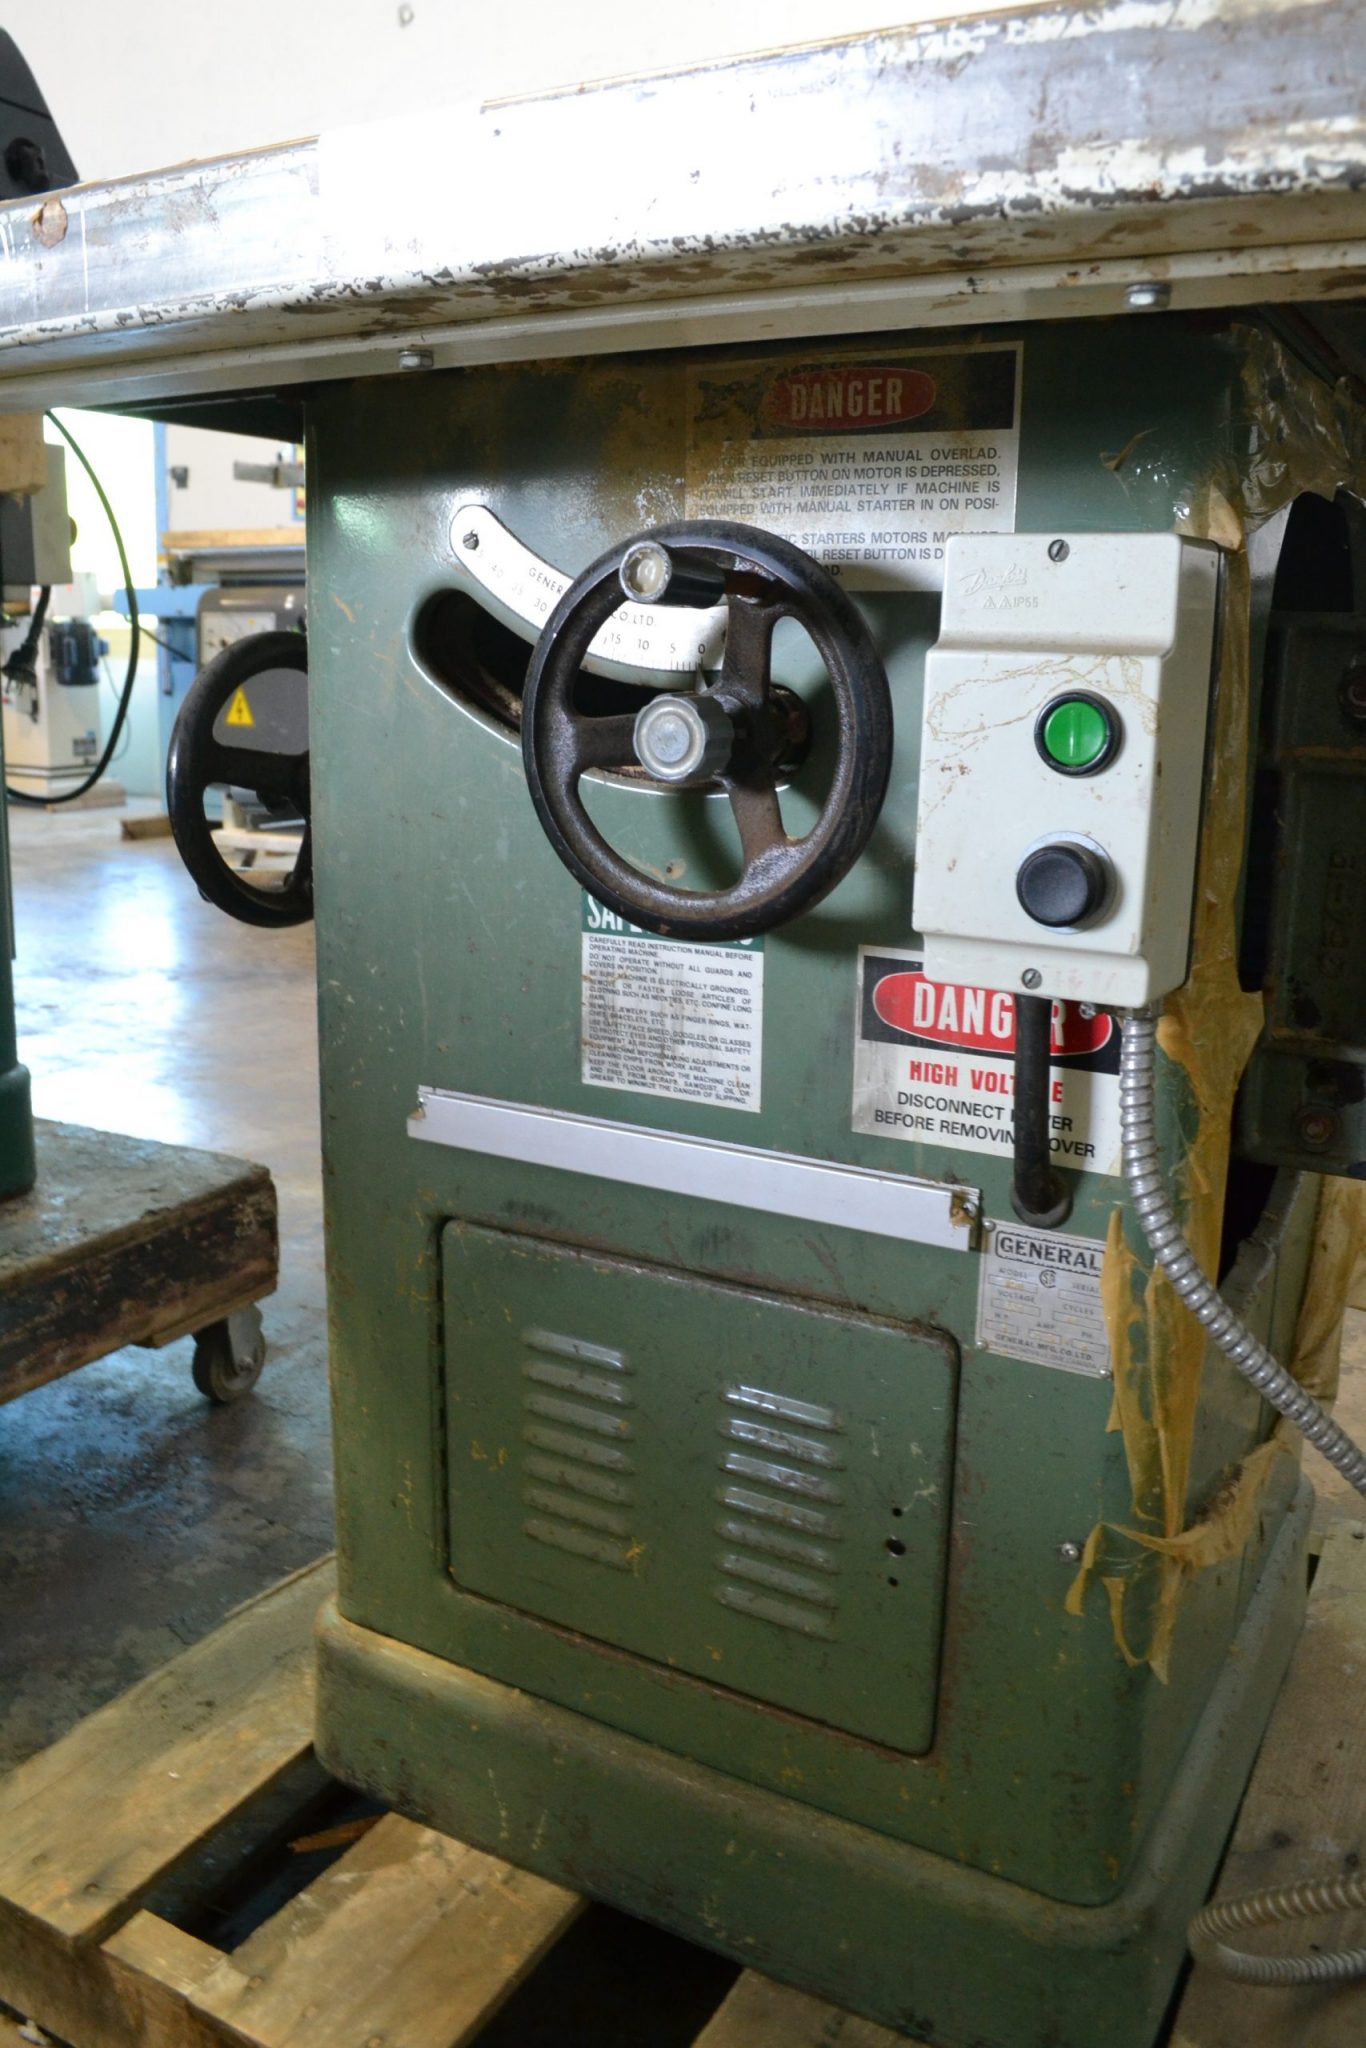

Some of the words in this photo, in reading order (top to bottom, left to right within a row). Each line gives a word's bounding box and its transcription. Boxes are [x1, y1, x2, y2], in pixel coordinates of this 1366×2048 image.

[791, 378, 903, 421] DANGER
[752, 453, 814, 467] EQUIPPED
[821, 452, 856, 464] WITH
[863, 450, 923, 463] MANUAL
[931, 448, 1001, 461] OVERLAD.
[738, 469, 775, 482] RESET
[778, 468, 830, 481] BUTTON
[833, 467, 850, 480] ON
[853, 467, 902, 479] MOTOR
[905, 466, 918, 478] IS
[920, 465, 1000, 478] DEPRESSED,
[752, 485, 791, 498] START
[800, 483, 889, 497] IMMEDIATELY
[896, 483, 908, 494] IF
[916, 481, 979, 494] MACHINE
[988, 481, 1000, 492] IS
[700, 501, 755, 515] EQUIPPED
[761, 501, 792, 514] WITH
[797, 499, 851, 513] MANUAL
[858, 498, 915, 512] STARTER
[921, 499, 933, 511] IN
[940, 498, 959, 510] ON
[965, 497, 1000, 510] POSI-
[801, 531, 865, 544] STARTERS
[871, 531, 927, 544] MOTORS
[822, 548, 861, 561] RESET
[864, 548, 916, 560] BUTTON
[919, 548, 931, 559] IS
[529, 568, 564, 595] GENER
[534, 598, 548, 612] 30
[638, 638, 649, 650] 10
[669, 643, 675, 653] 5
[698, 643, 705, 654] 0
[589, 936, 625, 946] CAREFULLY
[628, 940, 645, 948] READ
[647, 942, 692, 954] INSTRUCTION
[694, 947, 722, 957] MANUAL
[725, 951, 752, 960] BEFORE
[589, 943, 625, 953] OPERATING
[589, 960, 614, 969] COVERS
[602, 954, 615, 962] NOT
[619, 956, 649, 966] OPERATE
[653, 960, 684, 970] WITHOUT
[688, 964, 700, 972] ALL
[704, 966, 733, 975] GUARDS
[737, 970, 752, 978] AND
[617, 973, 647, 982] MACHINE
[658, 978, 706, 989] ELECTRICALLY
[622, 990, 638, 998] SUCH
[702, 1000, 730, 1010] CONFINE
[732, 1004, 752, 1013] LONG
[638, 984, 664, 994] FASTEN
[671, 989, 694, 997] LOOSE
[701, 992, 735, 1003] ARTICLES
[741, 997, 751, 1005] OF
[681, 1014, 706, 1024] FINGER
[913, 982, 1066, 1046] DANGR
[687, 1040, 721, 1051] PERSONAL
[724, 1045, 750, 1055] SAFETY
[708, 1035, 718, 1043] OR
[719, 1037, 751, 1047] GLASSES
[691, 1057, 738, 1070] ADJUSTMENTS
[627, 1078, 655, 1089] MINIMIZE
[658, 1083, 671, 1091] THE
[673, 1086, 701, 1096] DANGER
[693, 1074, 723, 1085] MACHINE
[910, 1060, 958, 1088] HIGH
[971, 1069, 1063, 1103] VOLE
[897, 1091, 1005, 1122] DISCONNECT
[875, 1109, 934, 1131] BEFORE
[940, 1122, 1015, 1145] REMOVIN
[1049, 1138, 1095, 1158] OVER
[1000, 1237, 1101, 1271] GENERAL
[1063, 1303, 1094, 1315] CYCLES
[995, 1333, 1034, 1347] GENERAL
